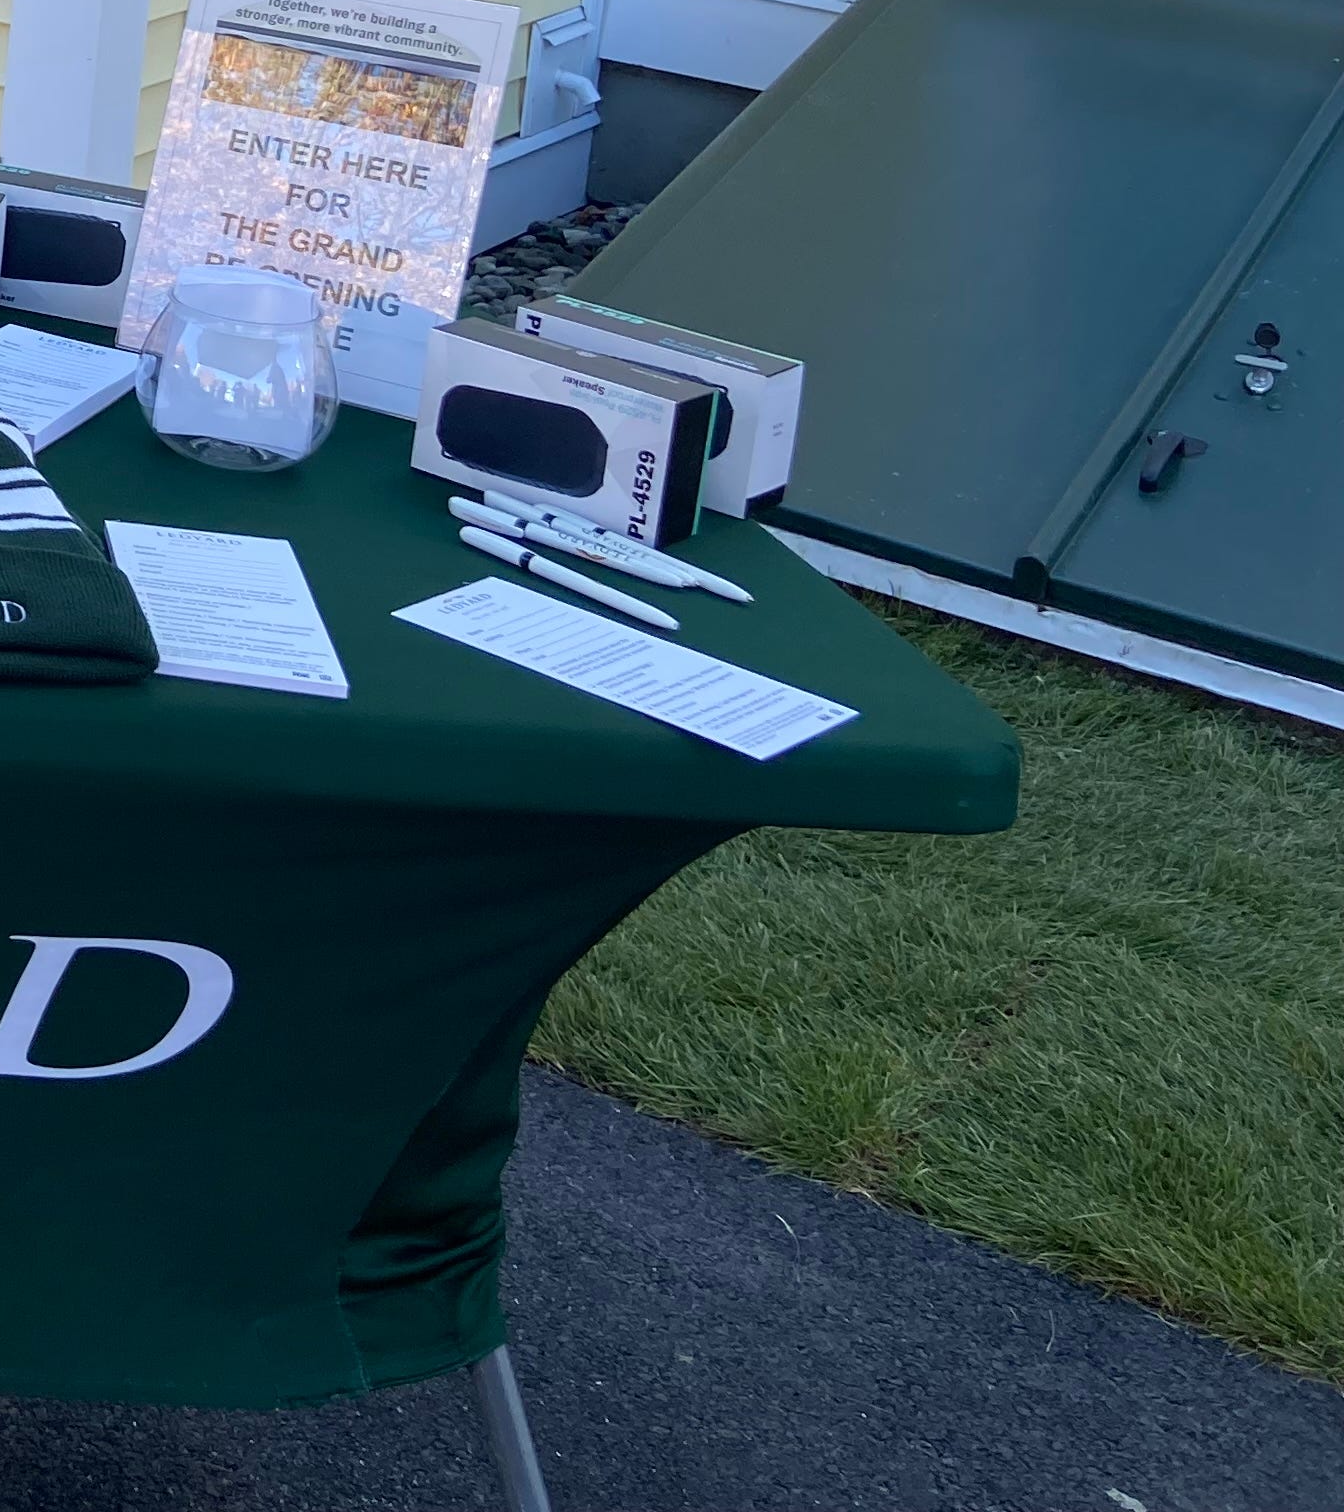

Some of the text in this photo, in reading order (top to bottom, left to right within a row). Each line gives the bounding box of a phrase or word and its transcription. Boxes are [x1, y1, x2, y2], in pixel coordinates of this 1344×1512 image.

[235, 7, 464, 57] stronger, more vibrant community.
[330, 8, 367, 23] we're
[370, 13, 425, 34] building
[428, 24, 437, 34] a
[227, 128, 431, 191] ENTER HERE
[284, 183, 352, 219] FOR
[220, 212, 403, 273] THE GRAND
[561, 376, 606, 396] Speaker
[628, 449, 656, 541] PL-4529
[156, 531, 242, 546] LEDYARD
[437, 592, 493, 616] LEDYARD
